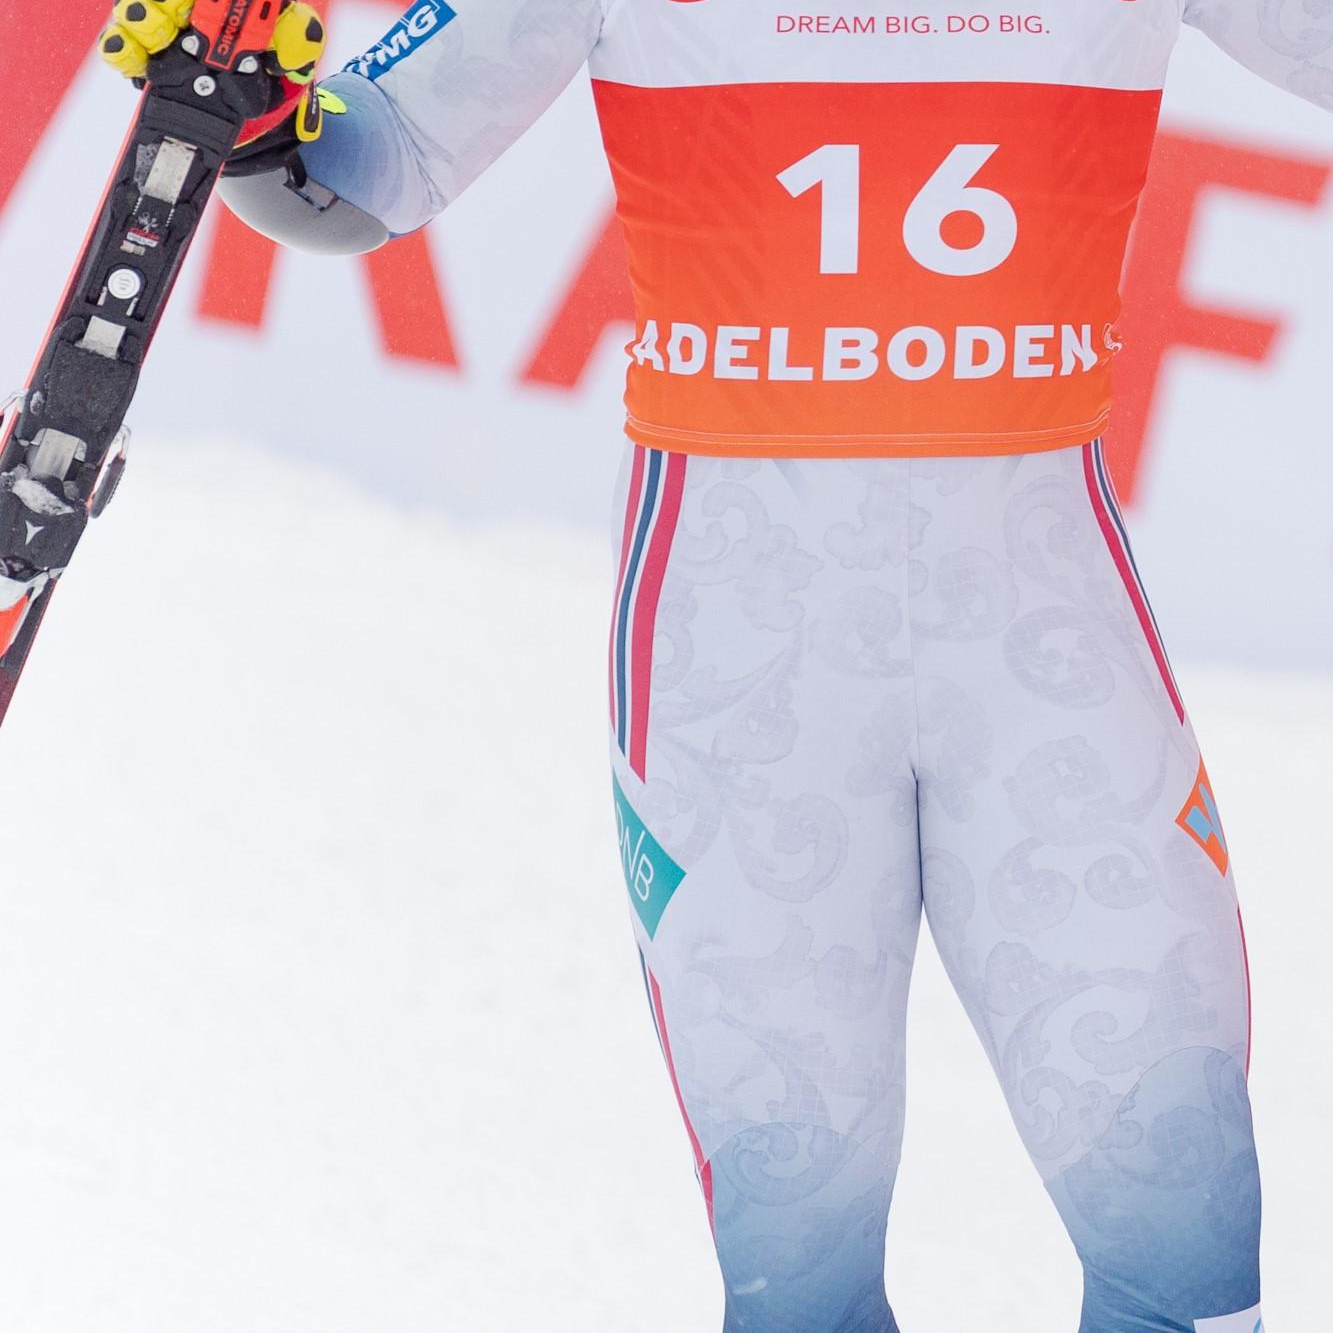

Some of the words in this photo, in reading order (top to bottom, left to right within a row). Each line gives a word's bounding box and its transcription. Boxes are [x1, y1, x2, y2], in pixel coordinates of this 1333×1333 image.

[776, 14, 875, 34] DREAM
[885, 14, 939, 34] BIG.
[947, 14, 990, 34] DO
[1000, 14, 1051, 35] BIG.
[775, 143, 1018, 277] 16
[631, 319, 1099, 382] ADELBODEN
